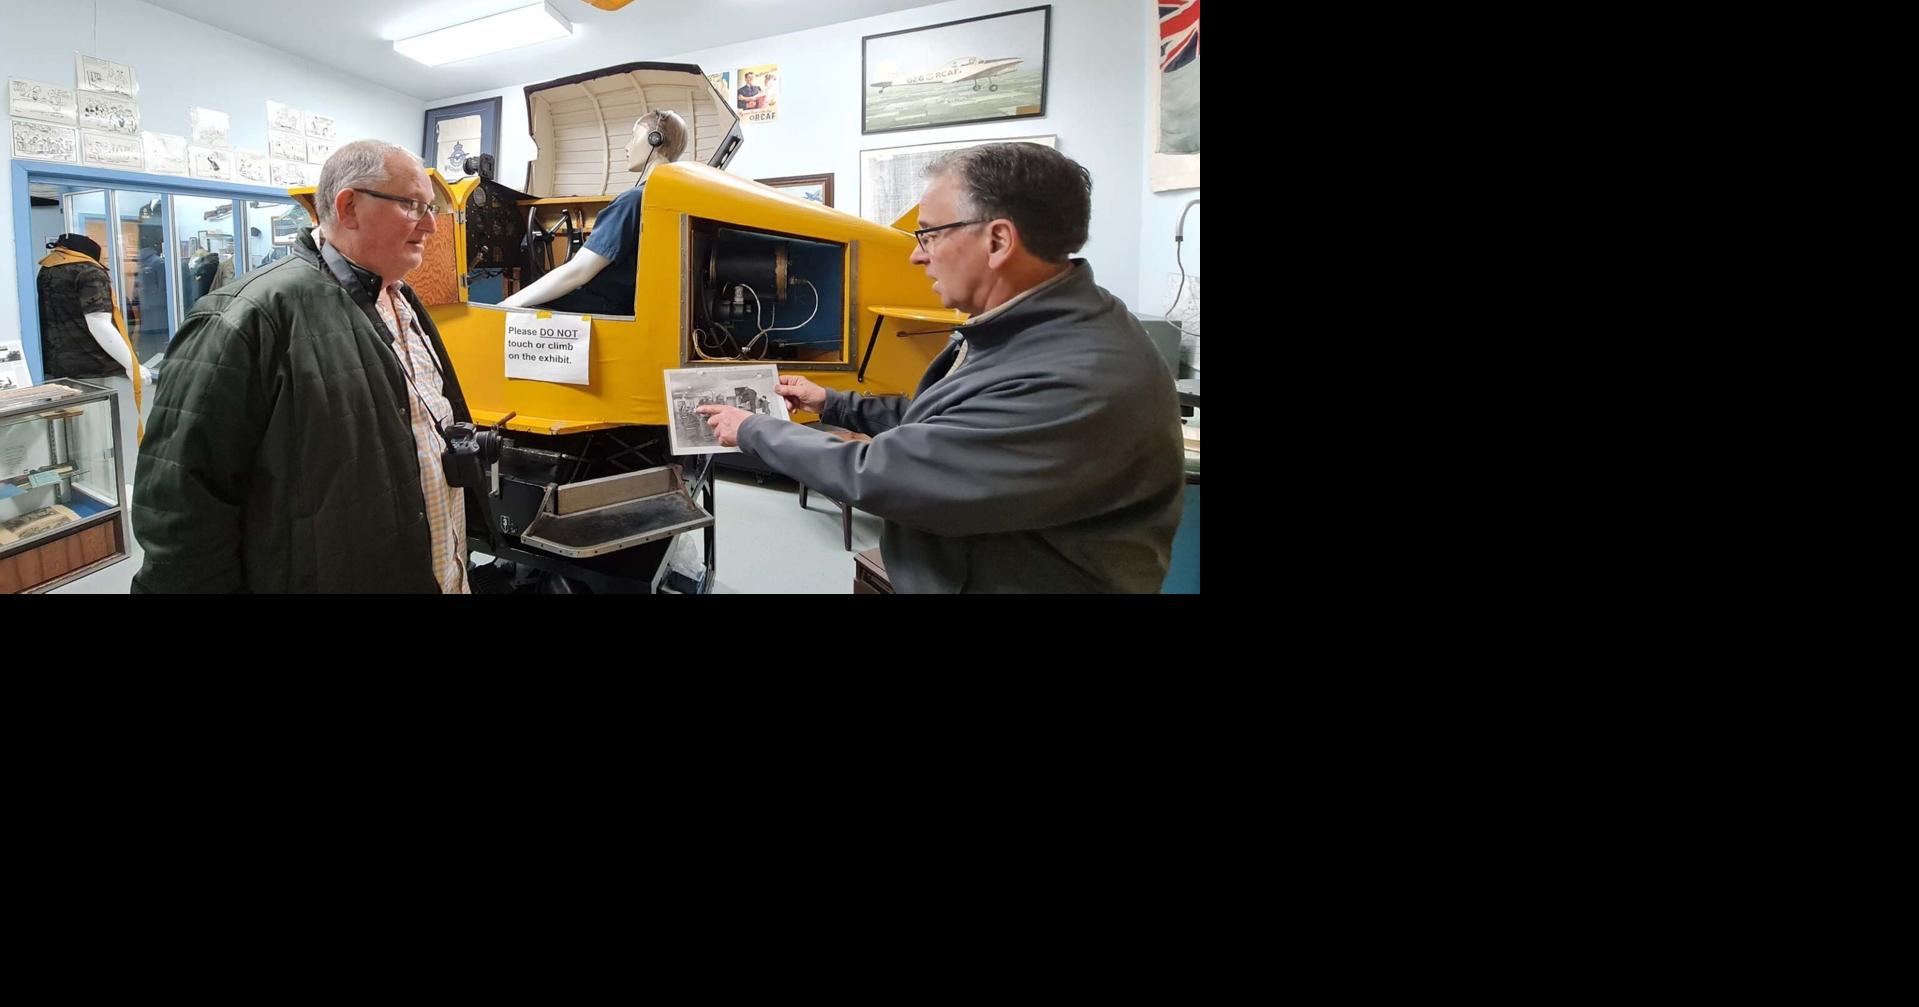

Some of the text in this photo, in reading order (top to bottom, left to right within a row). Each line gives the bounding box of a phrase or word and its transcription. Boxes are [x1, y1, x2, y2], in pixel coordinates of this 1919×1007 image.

[508, 326, 578, 339] Please DO NOT
[508, 340, 533, 348] touch
[548, 342, 574, 351] climb
[522, 353, 536, 361] the
[538, 354, 572, 364] exhibit.
